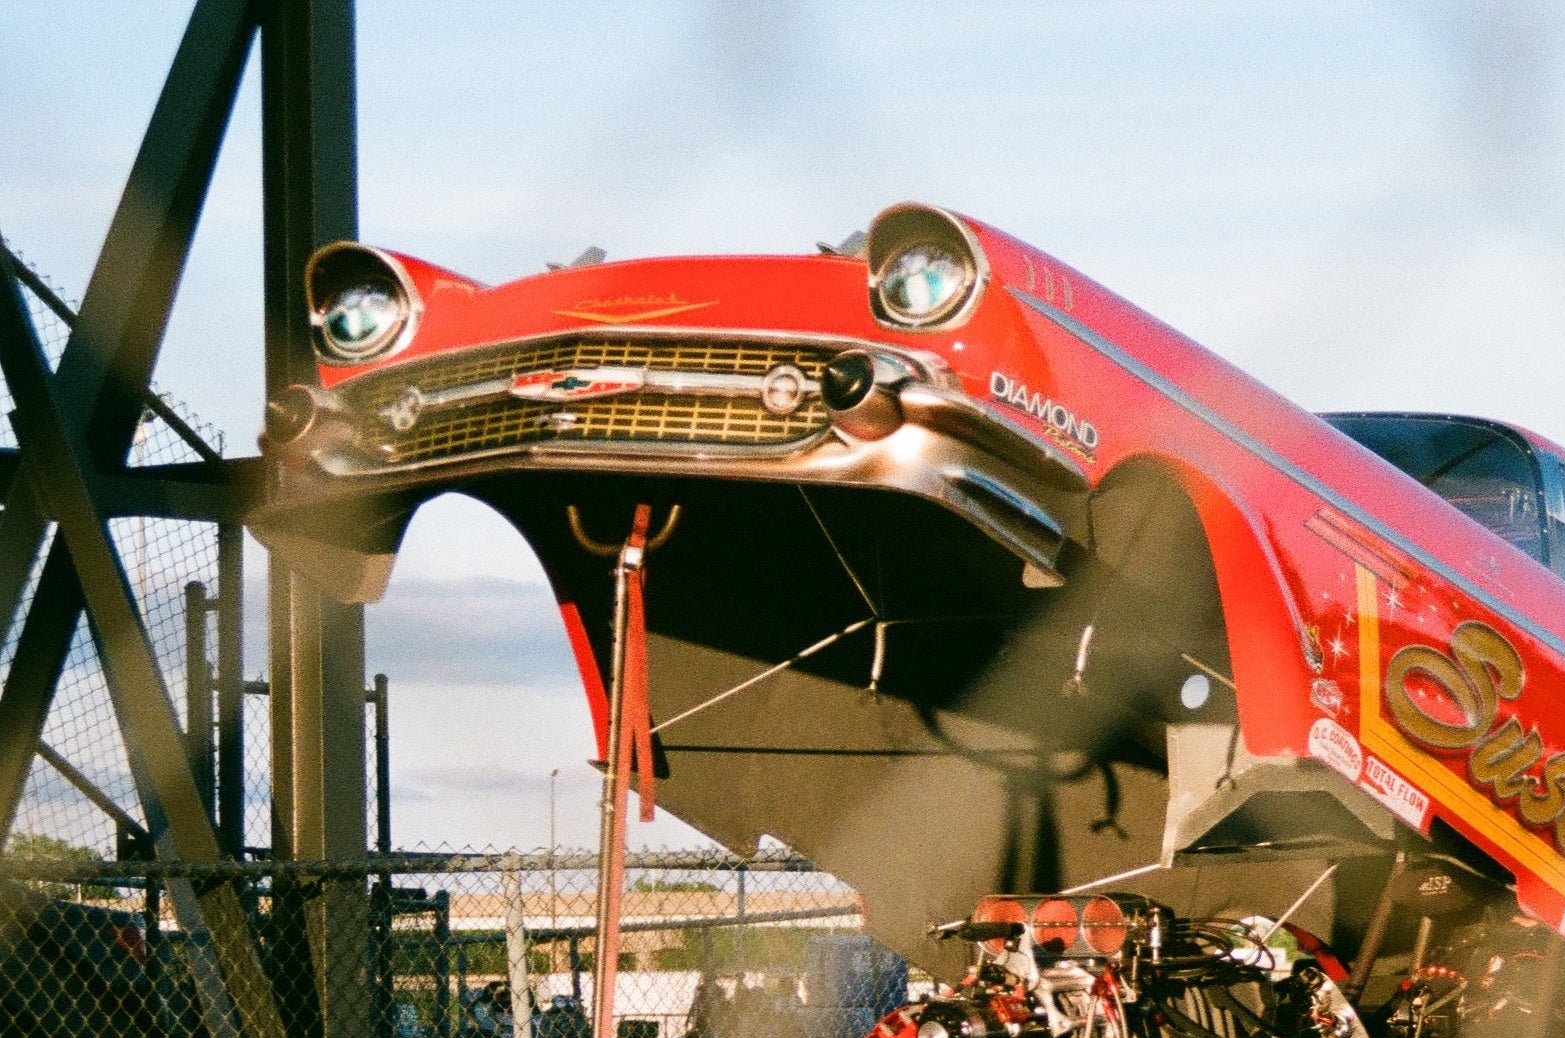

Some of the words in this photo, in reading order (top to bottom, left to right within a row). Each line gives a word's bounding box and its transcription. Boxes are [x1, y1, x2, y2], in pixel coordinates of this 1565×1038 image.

[990, 369, 1098, 449] DIAMOND
[1367, 760, 1397, 791] TOTAL
[1397, 782, 1425, 811] FLOW
